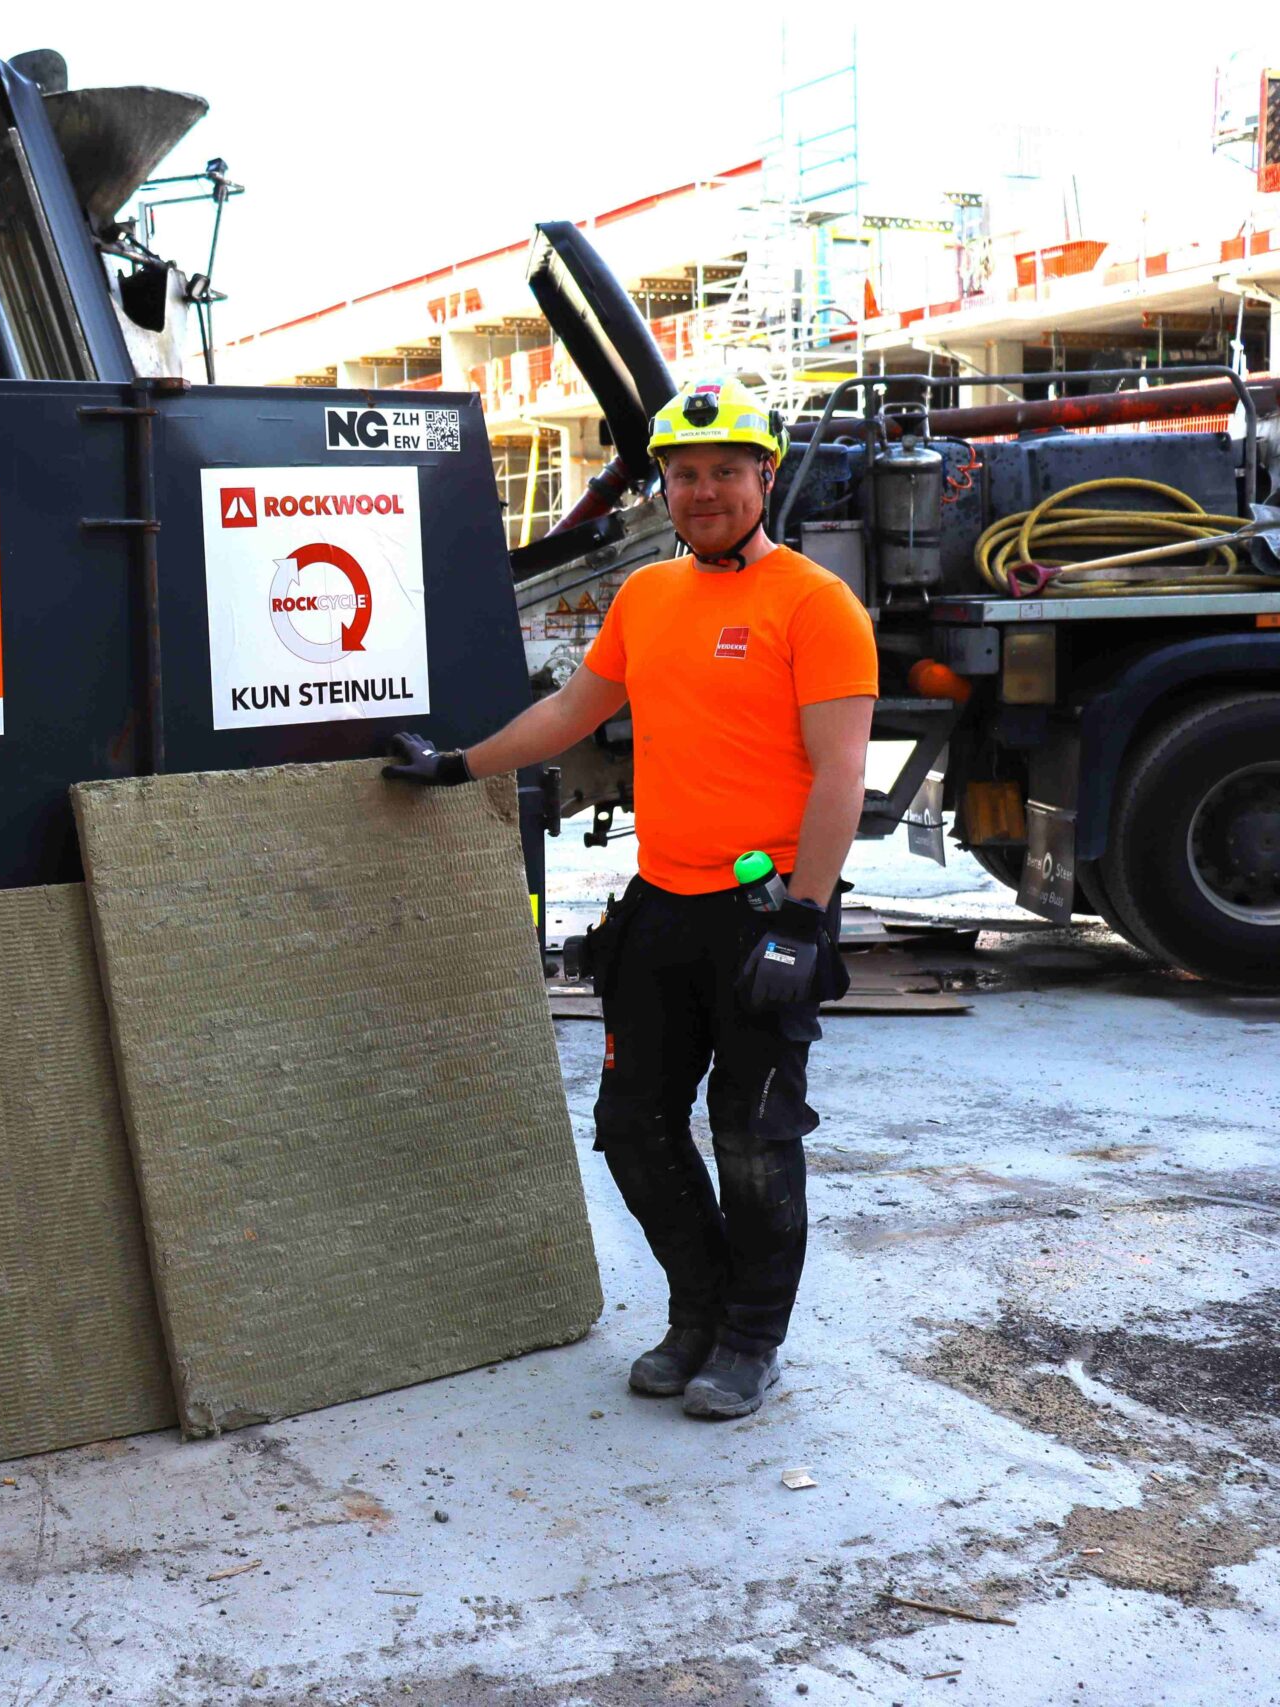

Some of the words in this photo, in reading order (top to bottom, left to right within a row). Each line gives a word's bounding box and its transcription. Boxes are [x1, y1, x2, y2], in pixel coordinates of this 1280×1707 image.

[327, 410, 389, 448] NG
[393, 412, 420, 426] ZLH
[394, 435, 421, 449] ERV
[263, 494, 404, 517] ROCKWOOL
[272, 594, 367, 612] ROCKCYCLE
[231, 684, 291, 711] KUN
[298, 677, 414, 706] STEINULL
